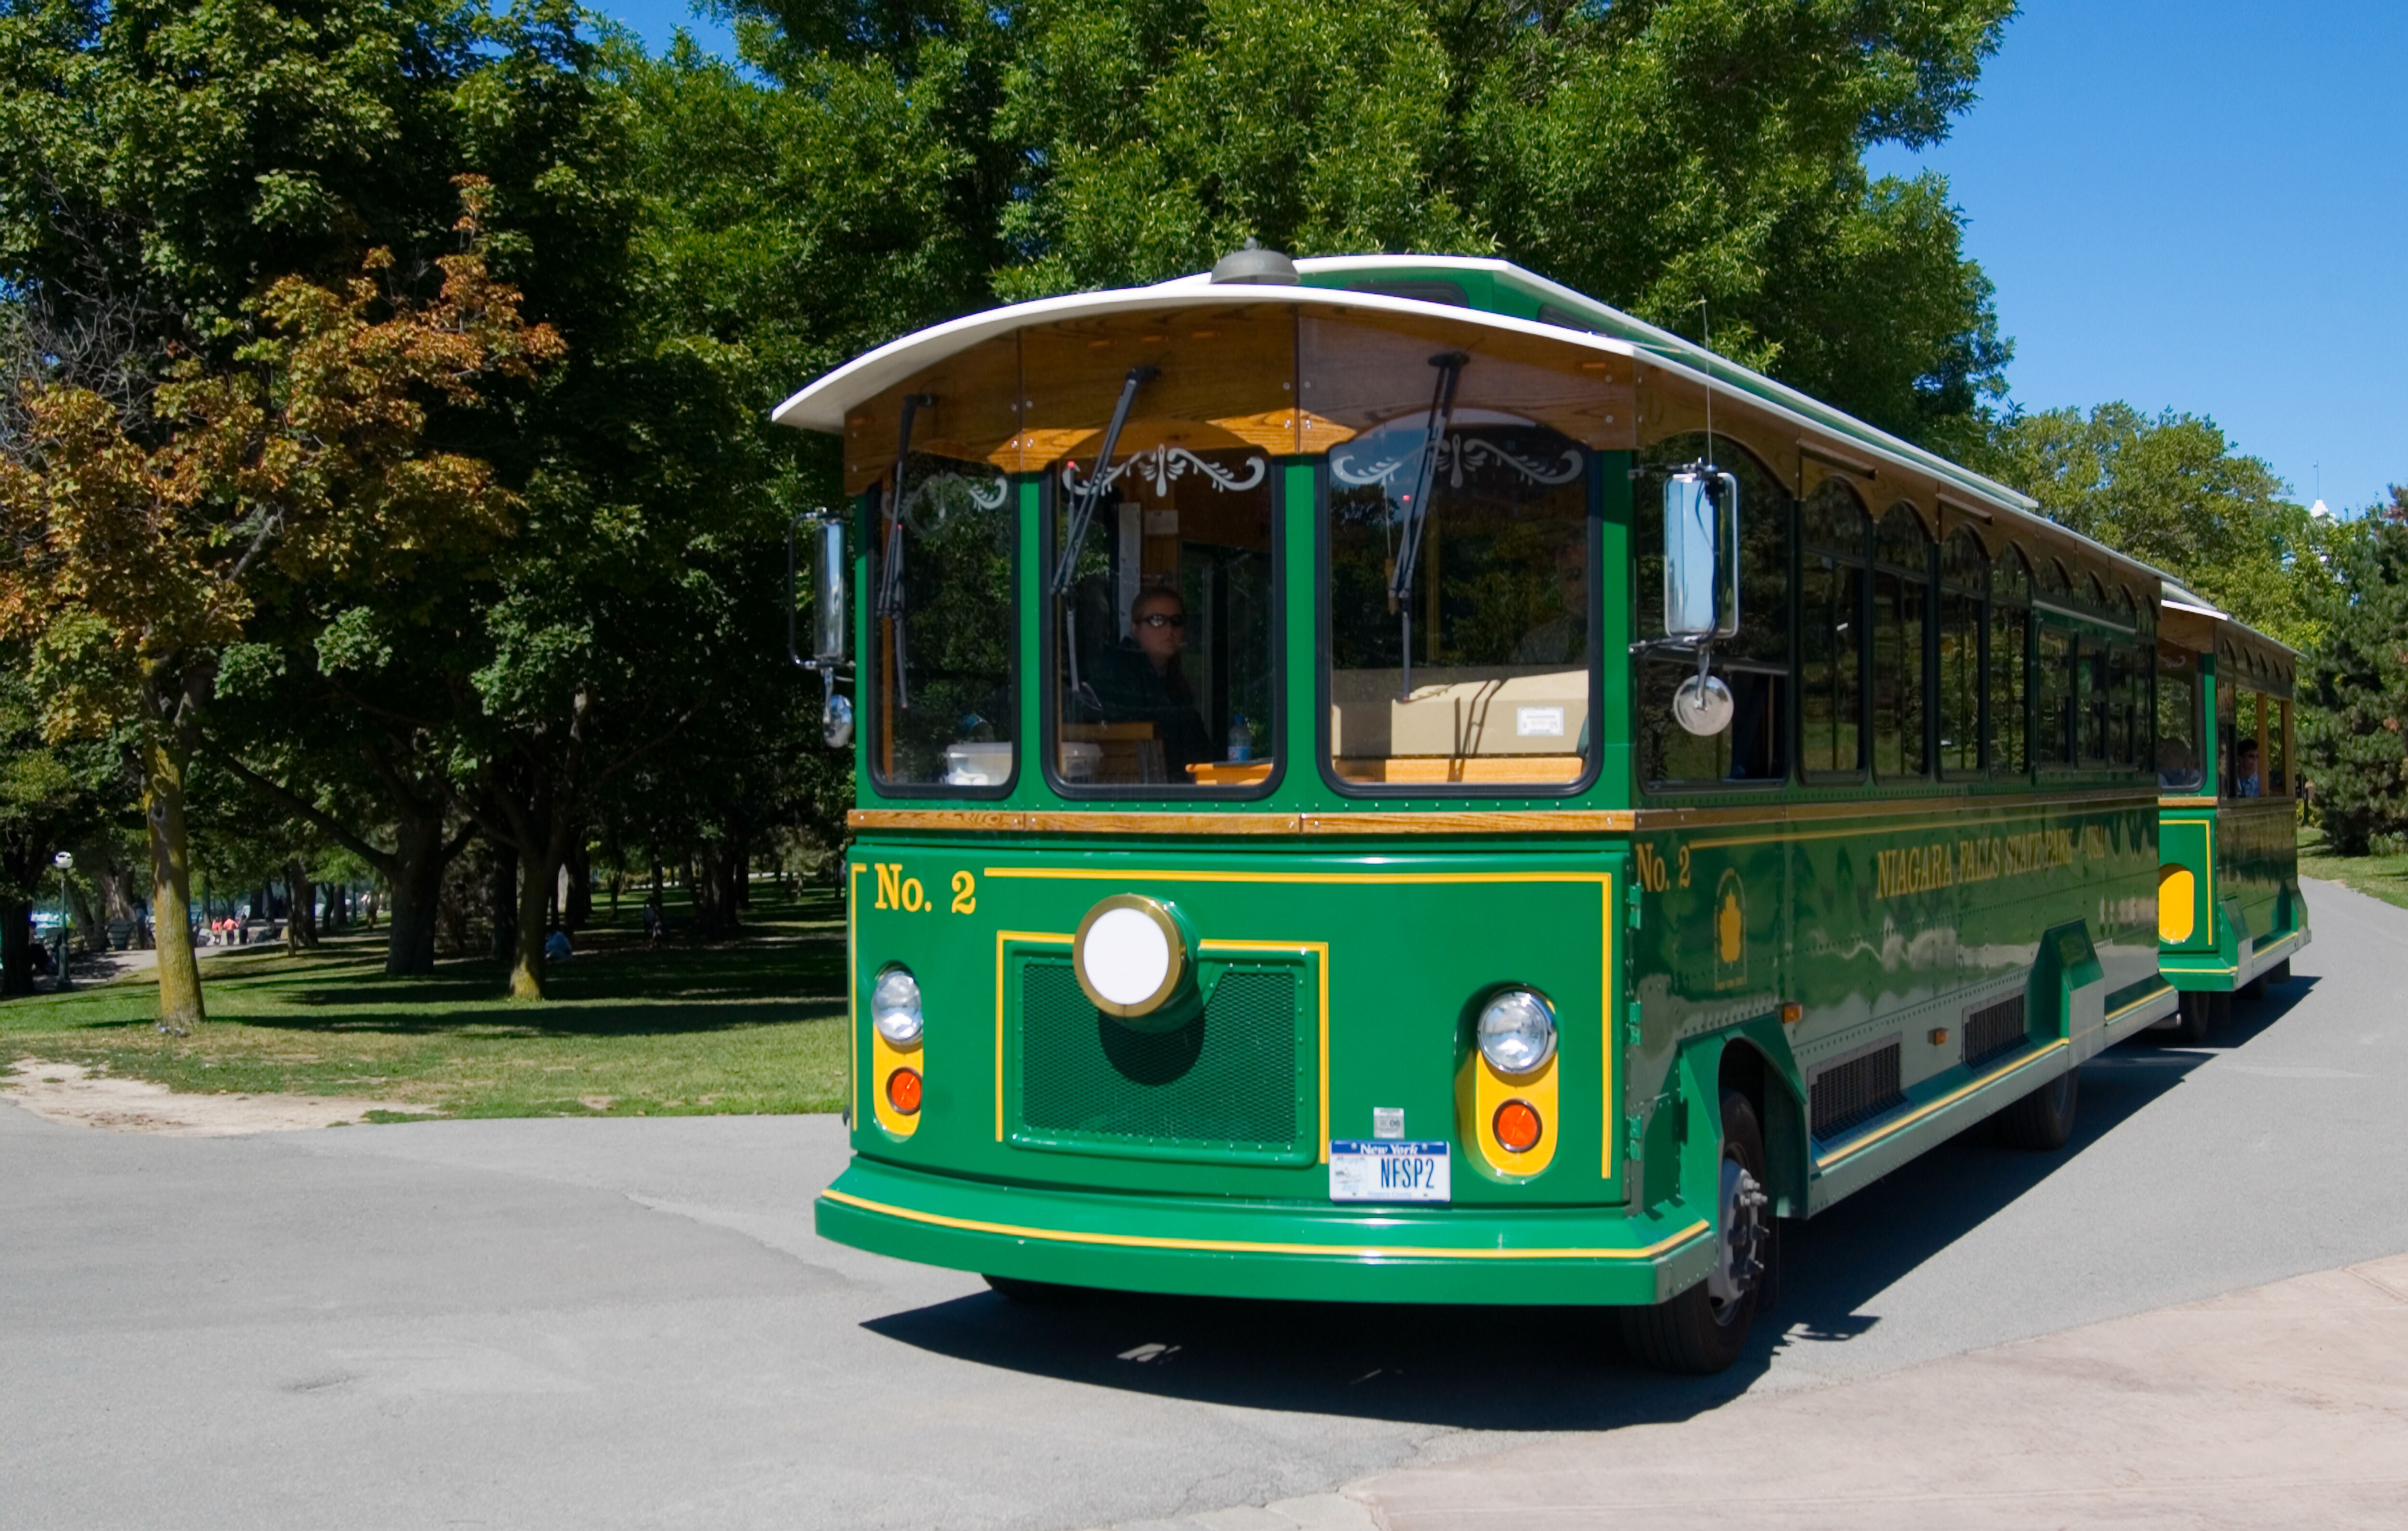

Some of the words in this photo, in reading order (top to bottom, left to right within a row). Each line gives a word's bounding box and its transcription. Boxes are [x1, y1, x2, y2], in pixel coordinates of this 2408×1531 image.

[1635, 843, 1670, 892] No.
[1678, 845, 1690, 888] 2
[1876, 843, 1953, 899] NIAGARA
[1958, 836, 2000, 883] FALLS
[2004, 832, 2042, 876] STATE
[2044, 828, 2073, 868] PARK
[874, 863, 932, 912] No.
[951, 870, 976, 915] 2
[1360, 1143, 1388, 1155] New
[1388, 1143, 1418, 1155] York
[1381, 1157, 1435, 1189] NFSP2
